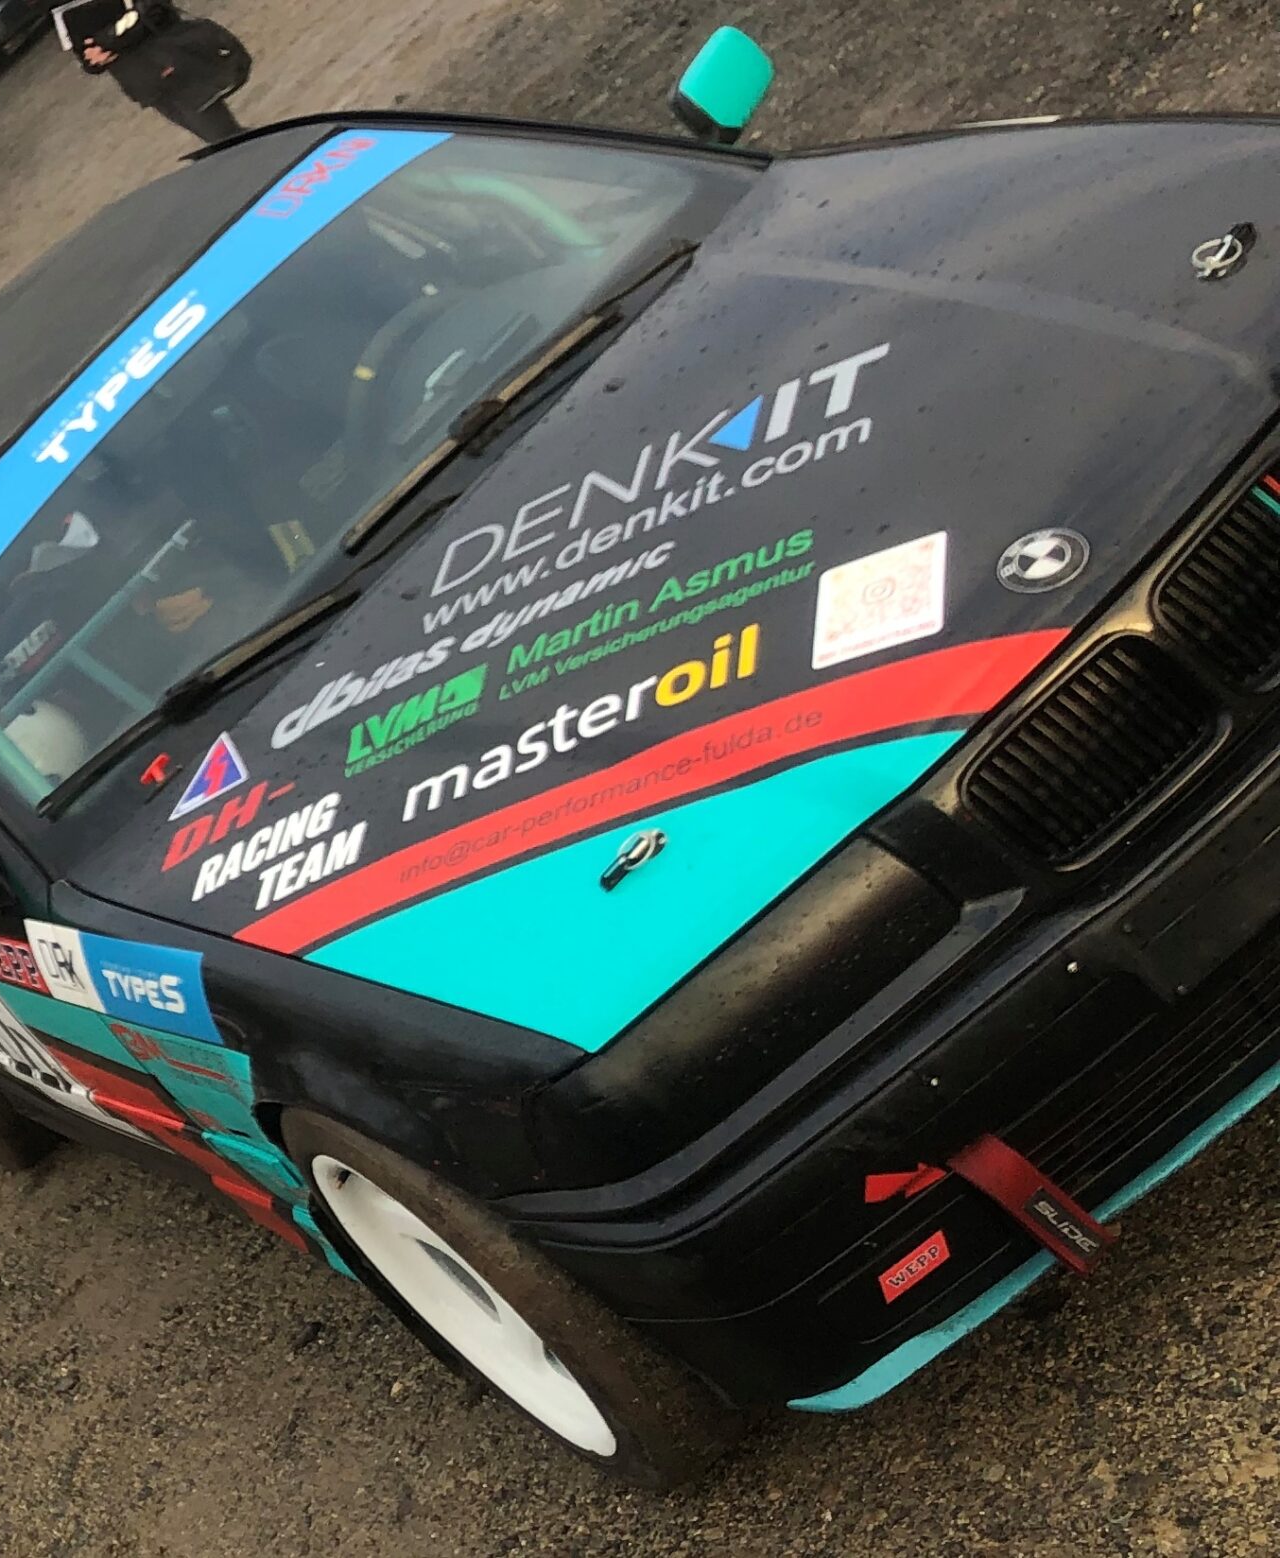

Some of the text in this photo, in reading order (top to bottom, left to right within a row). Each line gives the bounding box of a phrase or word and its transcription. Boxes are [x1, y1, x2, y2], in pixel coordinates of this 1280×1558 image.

[35, 300, 208, 464] TYPES
[423, 417, 872, 634] www.denkit.com
[271, 540, 675, 750] dbilas dynamic
[499, 665, 550, 701] LVM
[555, 560, 816, 676] Versicherungsagentur
[506, 528, 814, 675] Martin Asmus
[344, 702, 480, 778] VERSICHERUNG
[346, 684, 442, 765] LVM
[402, 622, 760, 822] masteroil
[191, 792, 342, 902] RACING
[398, 708, 822, 884] info@car-performance-fulda.de
[254, 820, 368, 911] TEAM
[100, 969, 186, 1014] TYPES
[887, 1244, 940, 1290] WEPP
[1031, 1200, 1097, 1254] SLIDE
